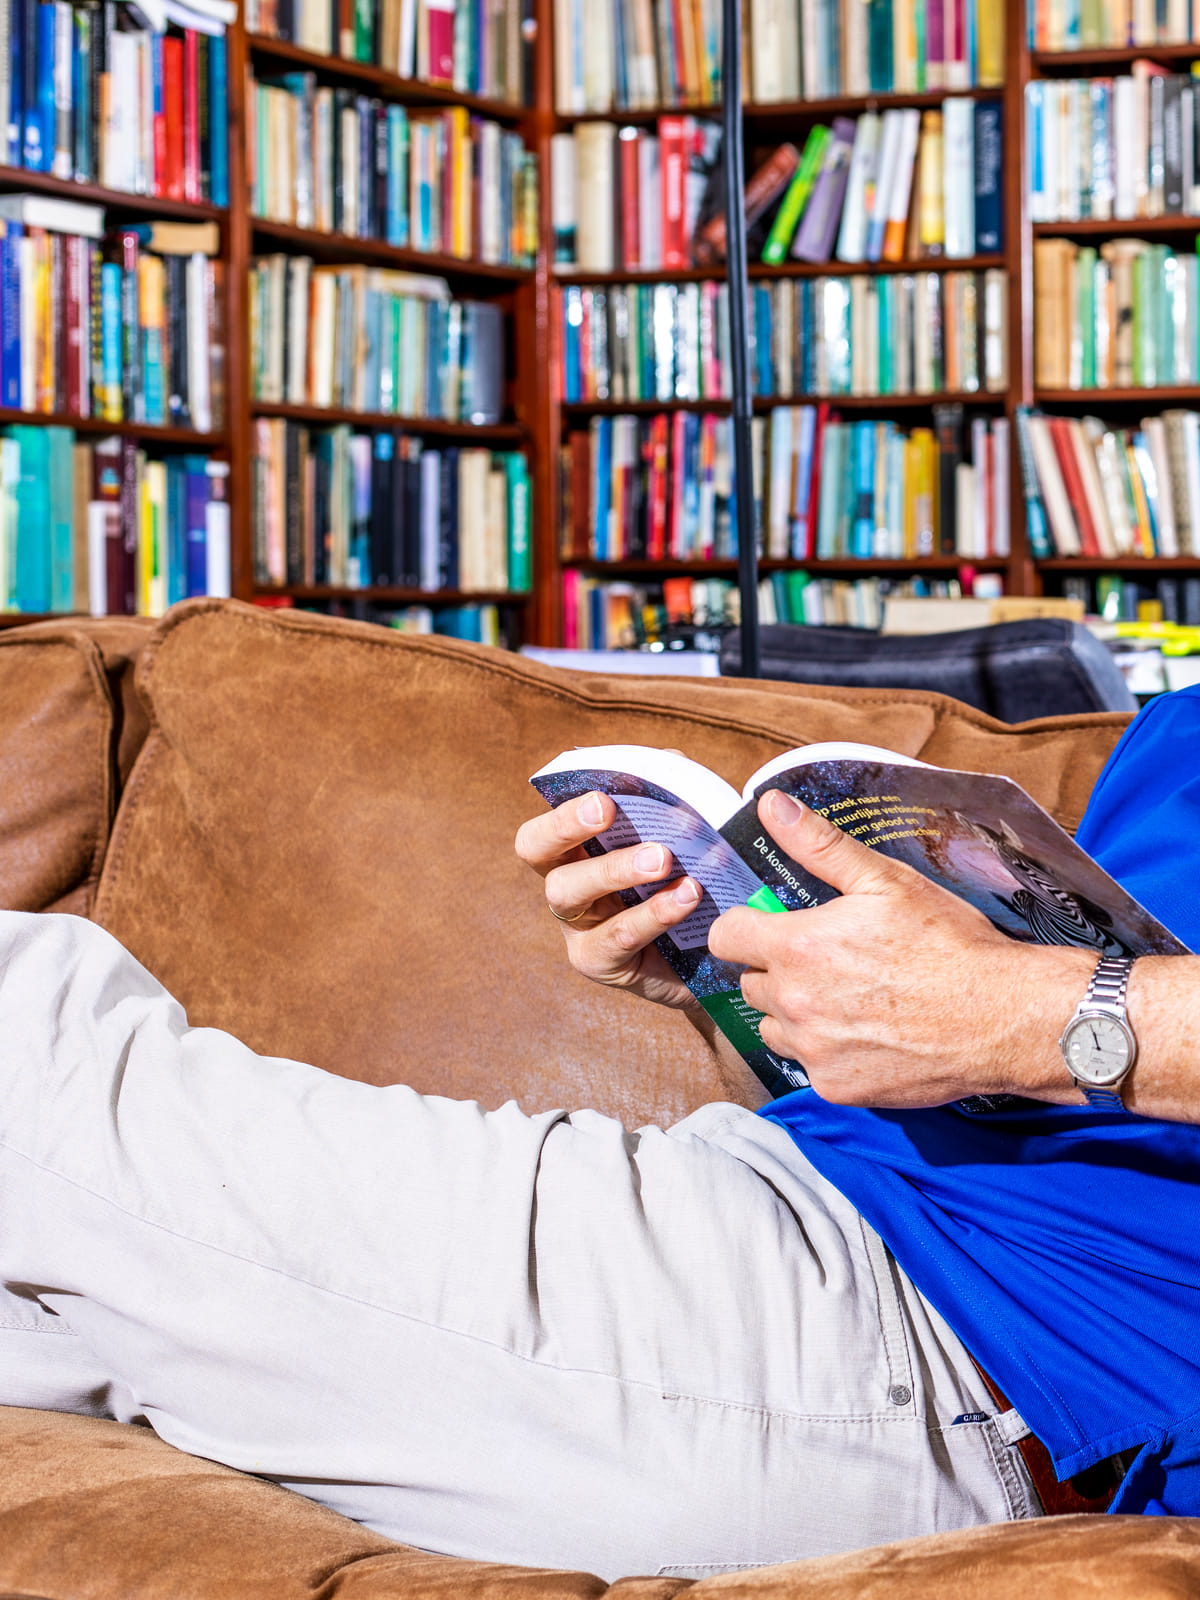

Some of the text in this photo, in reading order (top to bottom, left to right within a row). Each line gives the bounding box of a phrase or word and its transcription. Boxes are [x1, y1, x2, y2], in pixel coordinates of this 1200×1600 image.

[829, 797, 858, 812] zoek
[858, 795, 881, 803] naar
[881, 805, 937, 816] verbinding
[870, 817, 905, 832] geloof
[753, 836, 769, 855] De
[765, 850, 800, 890] kosmos
[797, 888, 813, 903] en
